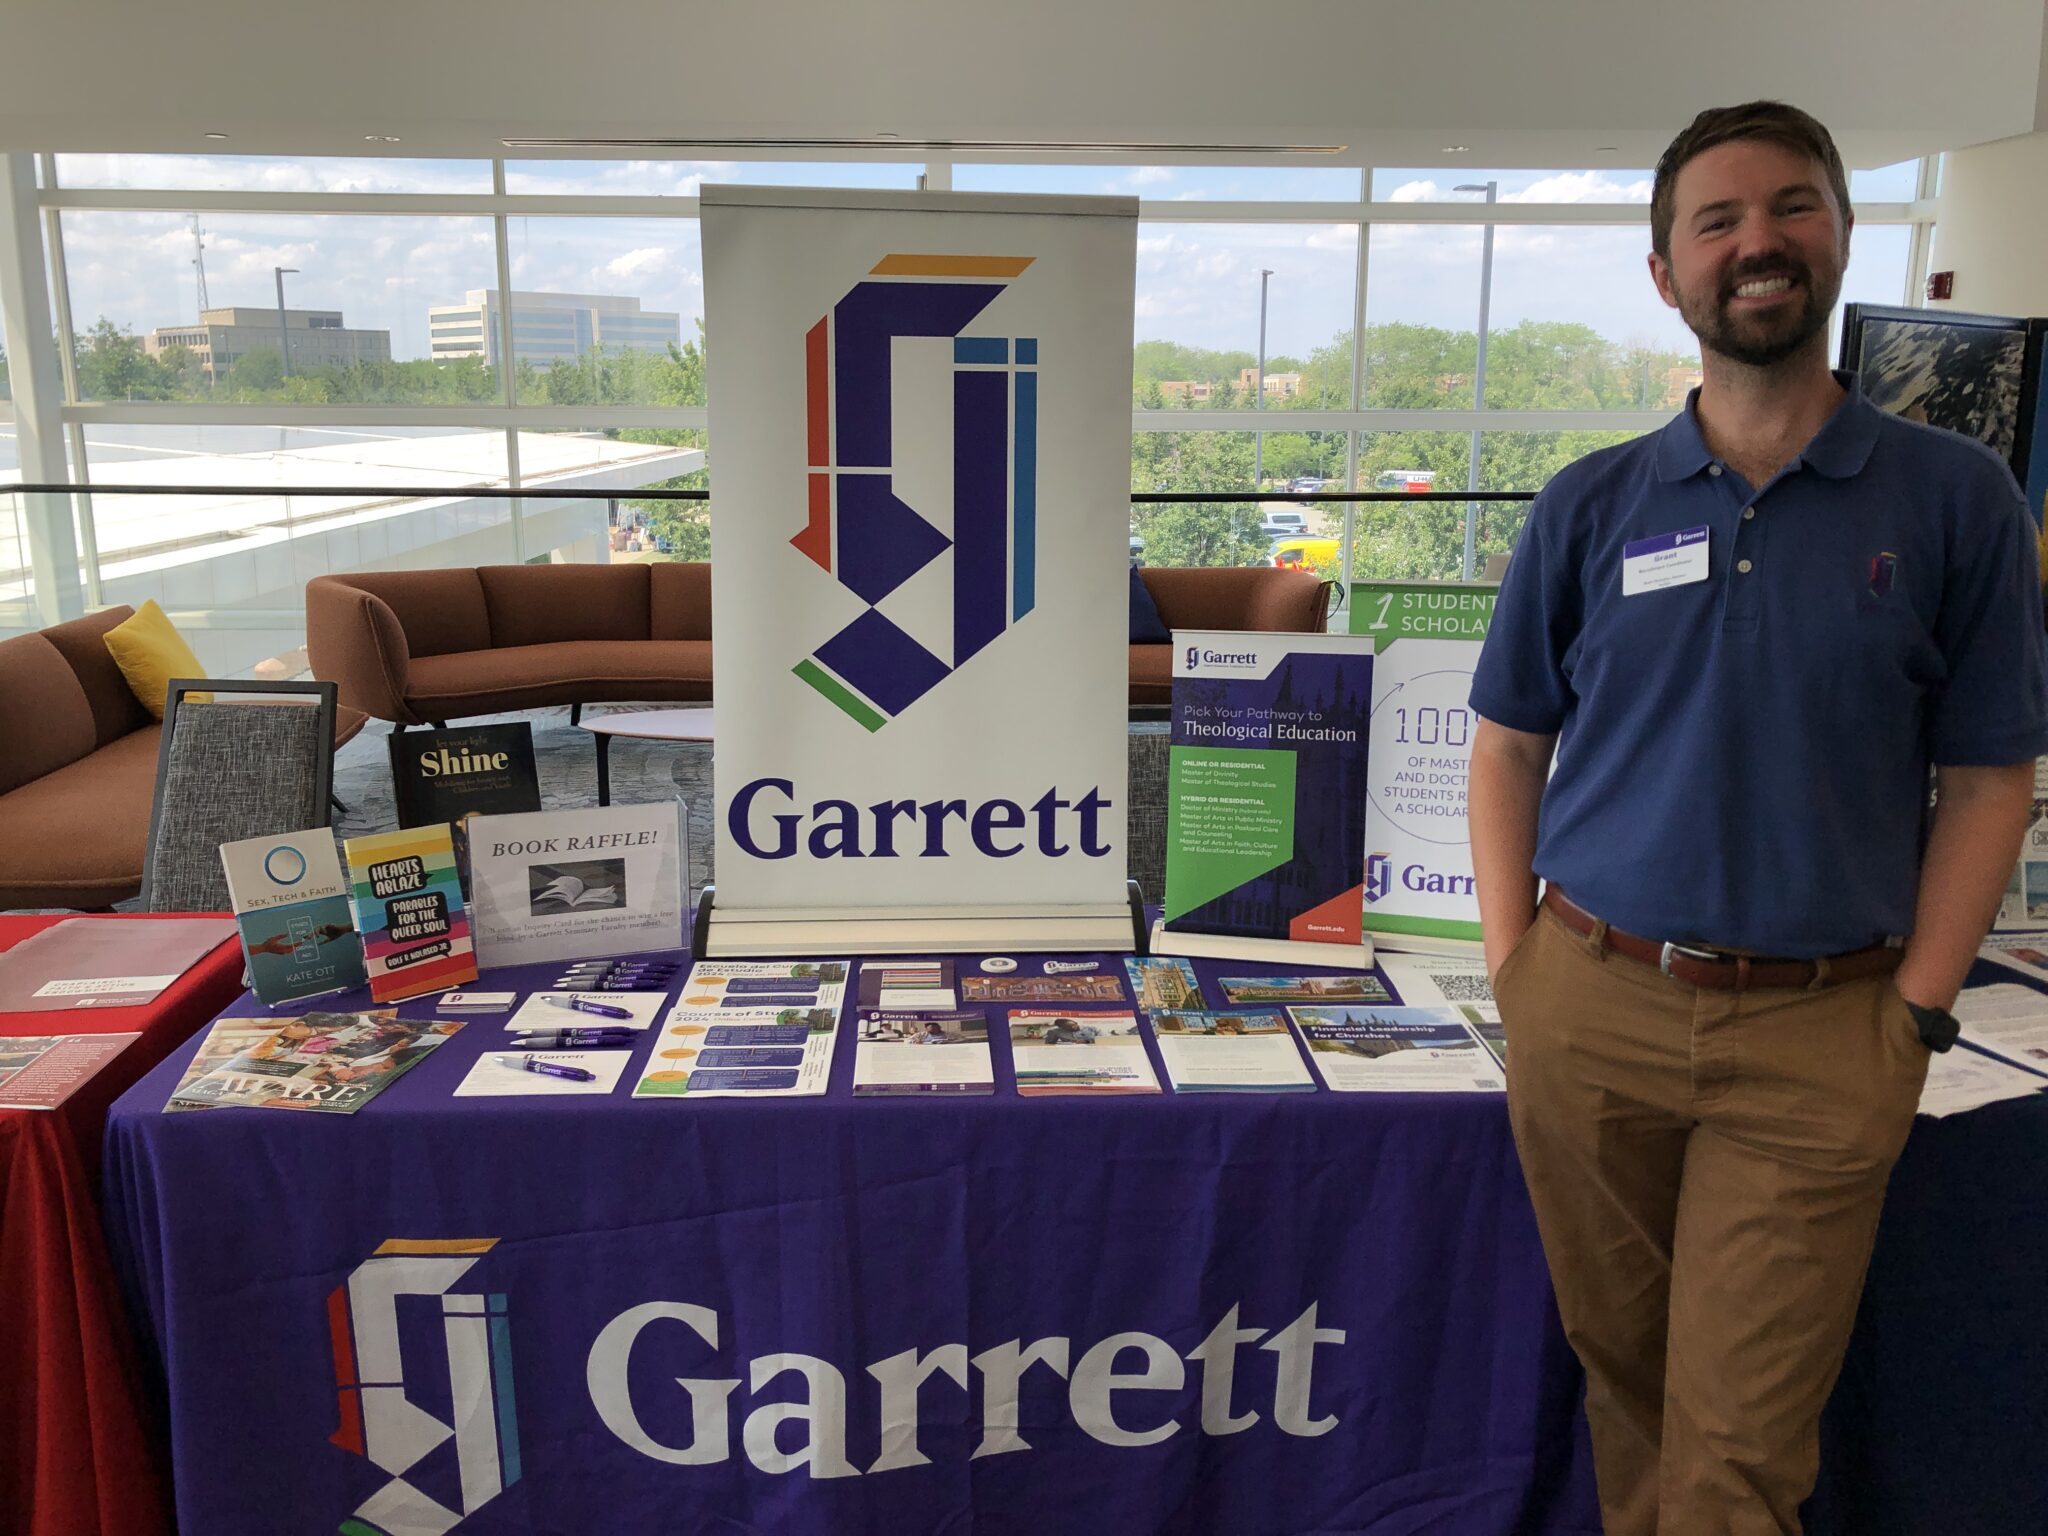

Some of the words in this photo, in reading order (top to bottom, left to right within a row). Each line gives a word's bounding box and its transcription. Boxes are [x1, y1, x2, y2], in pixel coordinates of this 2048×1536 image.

[1369, 592, 1394, 629] 1
[1203, 650, 1257, 665] Garrett
[1184, 706, 1211, 717] Pick
[1214, 706, 1243, 717] Your
[1247, 707, 1304, 723] Pathway
[1308, 712, 1322, 721] to
[1183, 720, 1273, 741] Theological
[1277, 724, 1356, 742] Education
[420, 747, 509, 777] Shine
[1182, 760, 1207, 768] ONLINE
[1220, 762, 1266, 770] RESIDENTIAL
[1408, 756, 1427, 768] OF
[1395, 772, 1425, 783] AND
[1181, 795, 1206, 803] HYBRID
[1220, 797, 1265, 805] RESIDENTIAL
[1384, 786, 1454, 801] STUDENTS
[1394, 803, 1404, 813] A
[728, 777, 1112, 860] Garrett
[492, 837, 560, 857] BOOK
[566, 830, 658, 850] RAFFLE!
[371, 858, 421, 882] HEARTS
[376, 873, 423, 896] ABLAZE
[273, 893, 298, 903] TECH
[309, 886, 337, 896] FAITH
[392, 895, 439, 914] PARABLES
[398, 912, 417, 925] FOR
[418, 908, 438, 920] THE
[392, 926, 422, 941] QUEER
[424, 920, 448, 934] SOUL
[535, 929, 562, 938] Garrett
[563, 925, 598, 936] Seminary
[1307, 924, 1345, 932] Garrett.edu
[387, 956, 404, 967] ROLF
[410, 947, 439, 960] NOLASCO
[286, 968, 313, 983] KATE
[315, 965, 337, 978] OTT
[755, 1010, 801, 1018] Study
[1369, 1025, 1436, 1034] Leadership
[540, 1065, 562, 1076] Garrett
[586, 1299, 1346, 1480] Garrett
